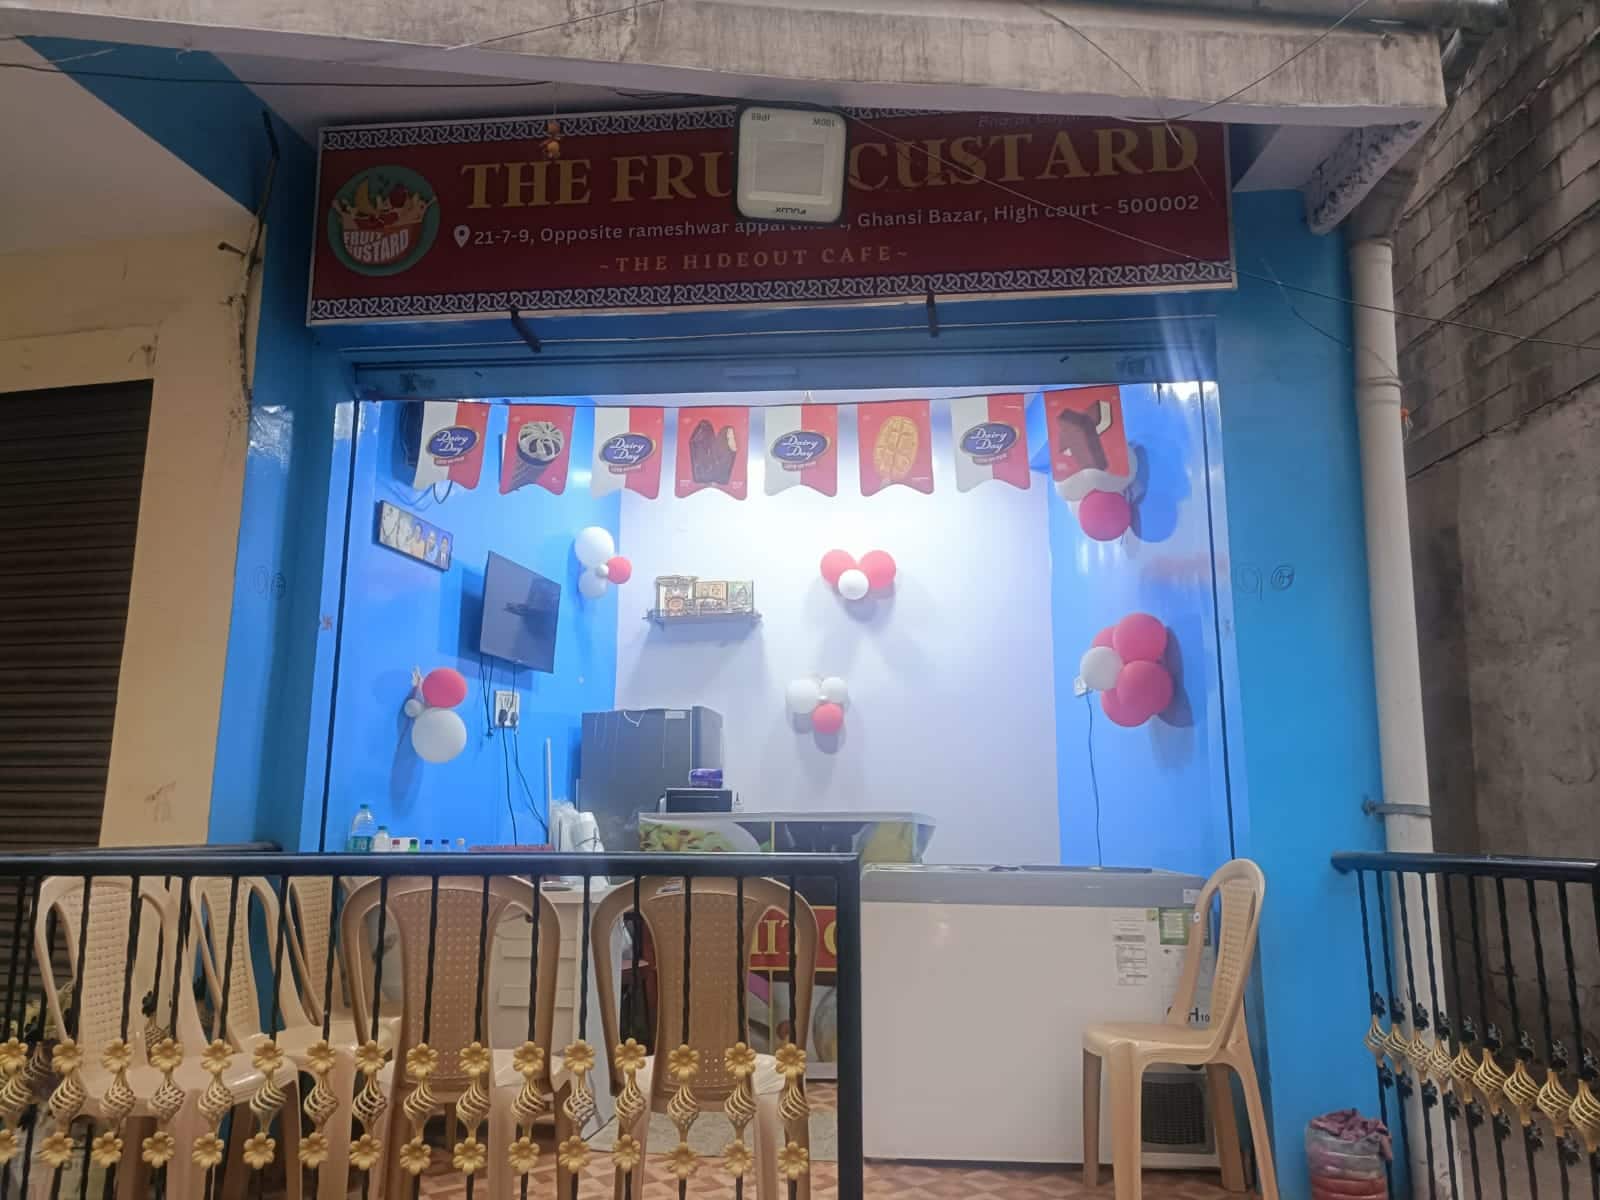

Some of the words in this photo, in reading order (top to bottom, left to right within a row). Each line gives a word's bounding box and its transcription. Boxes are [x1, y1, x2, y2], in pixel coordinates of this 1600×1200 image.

[812, 117, 836, 128] 100W
[461, 159, 592, 209] THE
[611, 151, 734, 202] FRU
[848, 124, 1198, 193] CUSTARD
[474, 228, 534, 246] 21-7-9,
[540, 225, 622, 245] Opposite
[628, 220, 729, 237] rameshwar
[857, 210, 922, 229] Ghansi
[928, 204, 987, 224] Bazar,
[994, 202, 1039, 222] High
[1045, 201, 1098, 217] court
[1117, 194, 1199, 214] 500002
[343, 231, 384, 246] FRUIT
[683, 249, 807, 270] HIDEOUT
[436, 430, 469, 446] Dairy
[780, 434, 819, 451] Dairy
[971, 426, 1008, 443] Dairy
[438, 442, 465, 456] Day
[608, 437, 646, 454] Dairy
[785, 444, 814, 461] Day
[975, 437, 1004, 455] Day
[612, 447, 640, 464] Day
